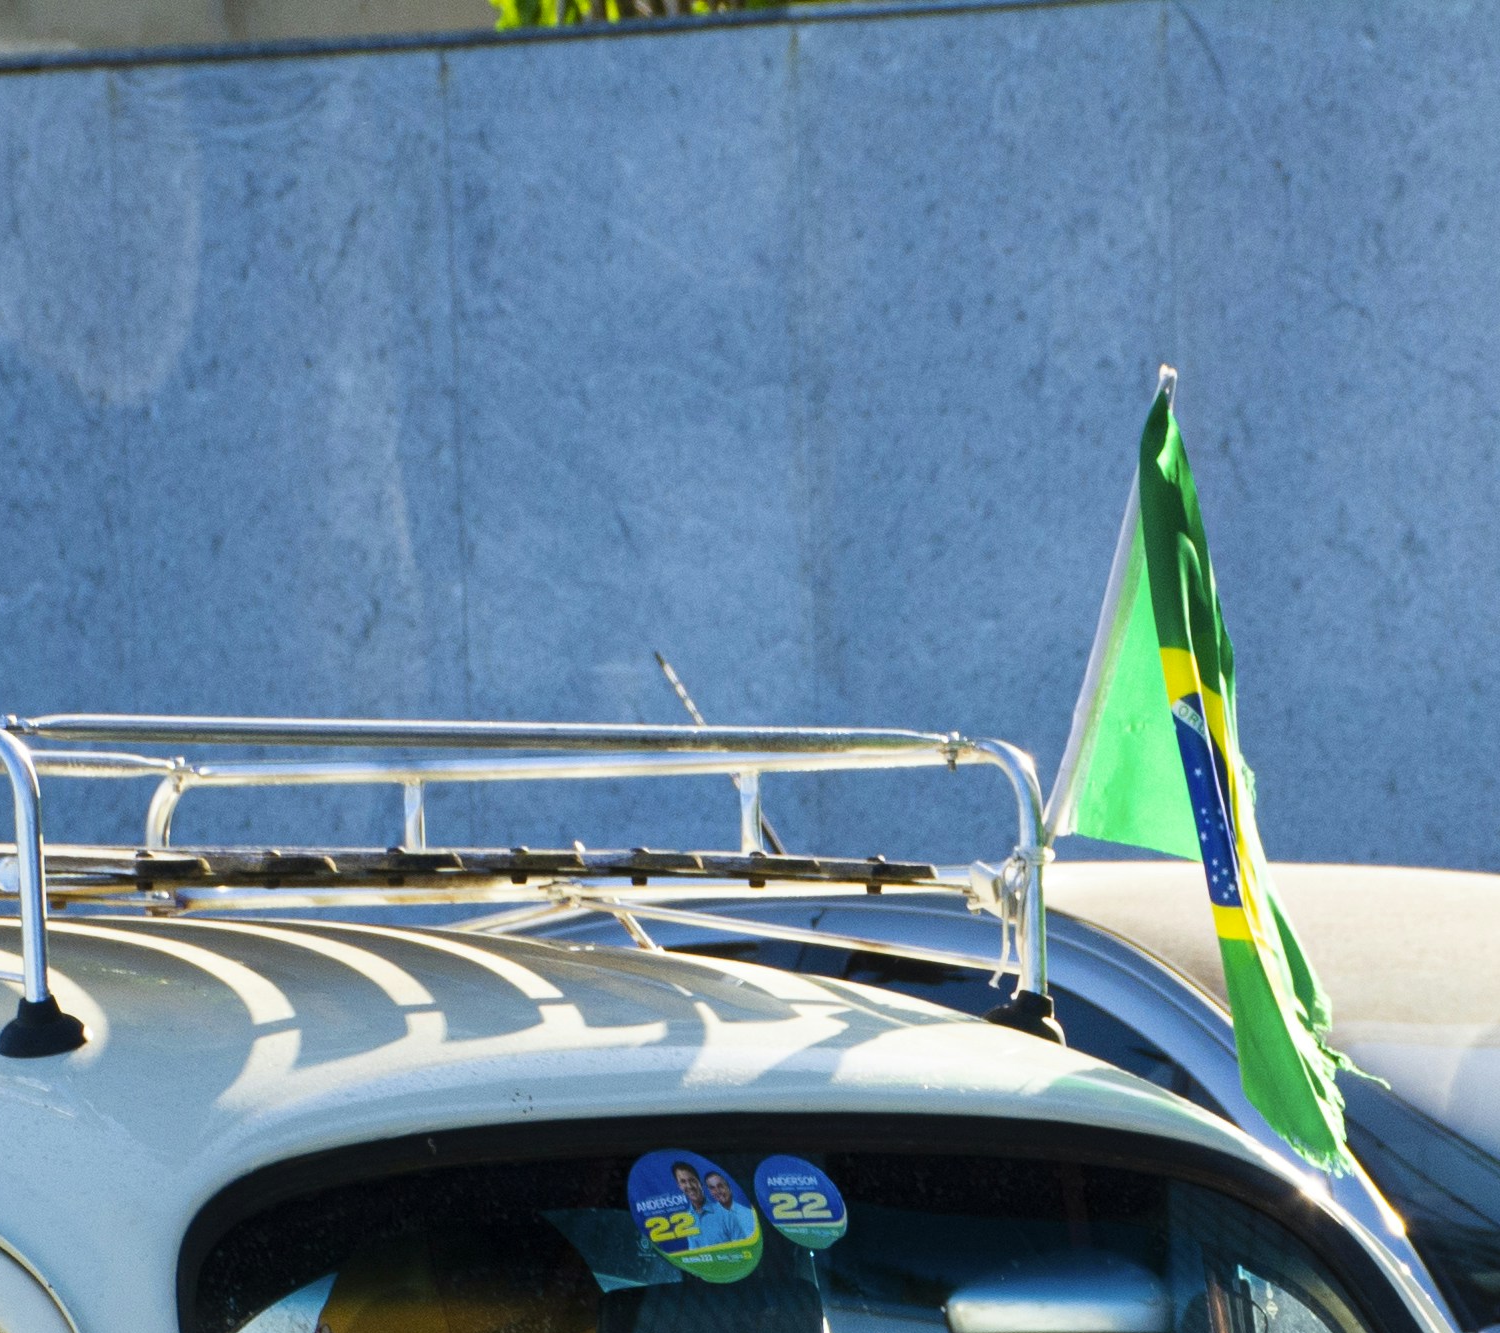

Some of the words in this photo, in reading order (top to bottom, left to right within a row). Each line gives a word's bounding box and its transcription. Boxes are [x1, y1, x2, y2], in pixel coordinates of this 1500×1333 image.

[767, 1175, 819, 1187] ANDERSON
[636, 1194, 688, 1212] ANDERSON
[769, 1192, 834, 1219] 22
[645, 1212, 700, 1242] 22
